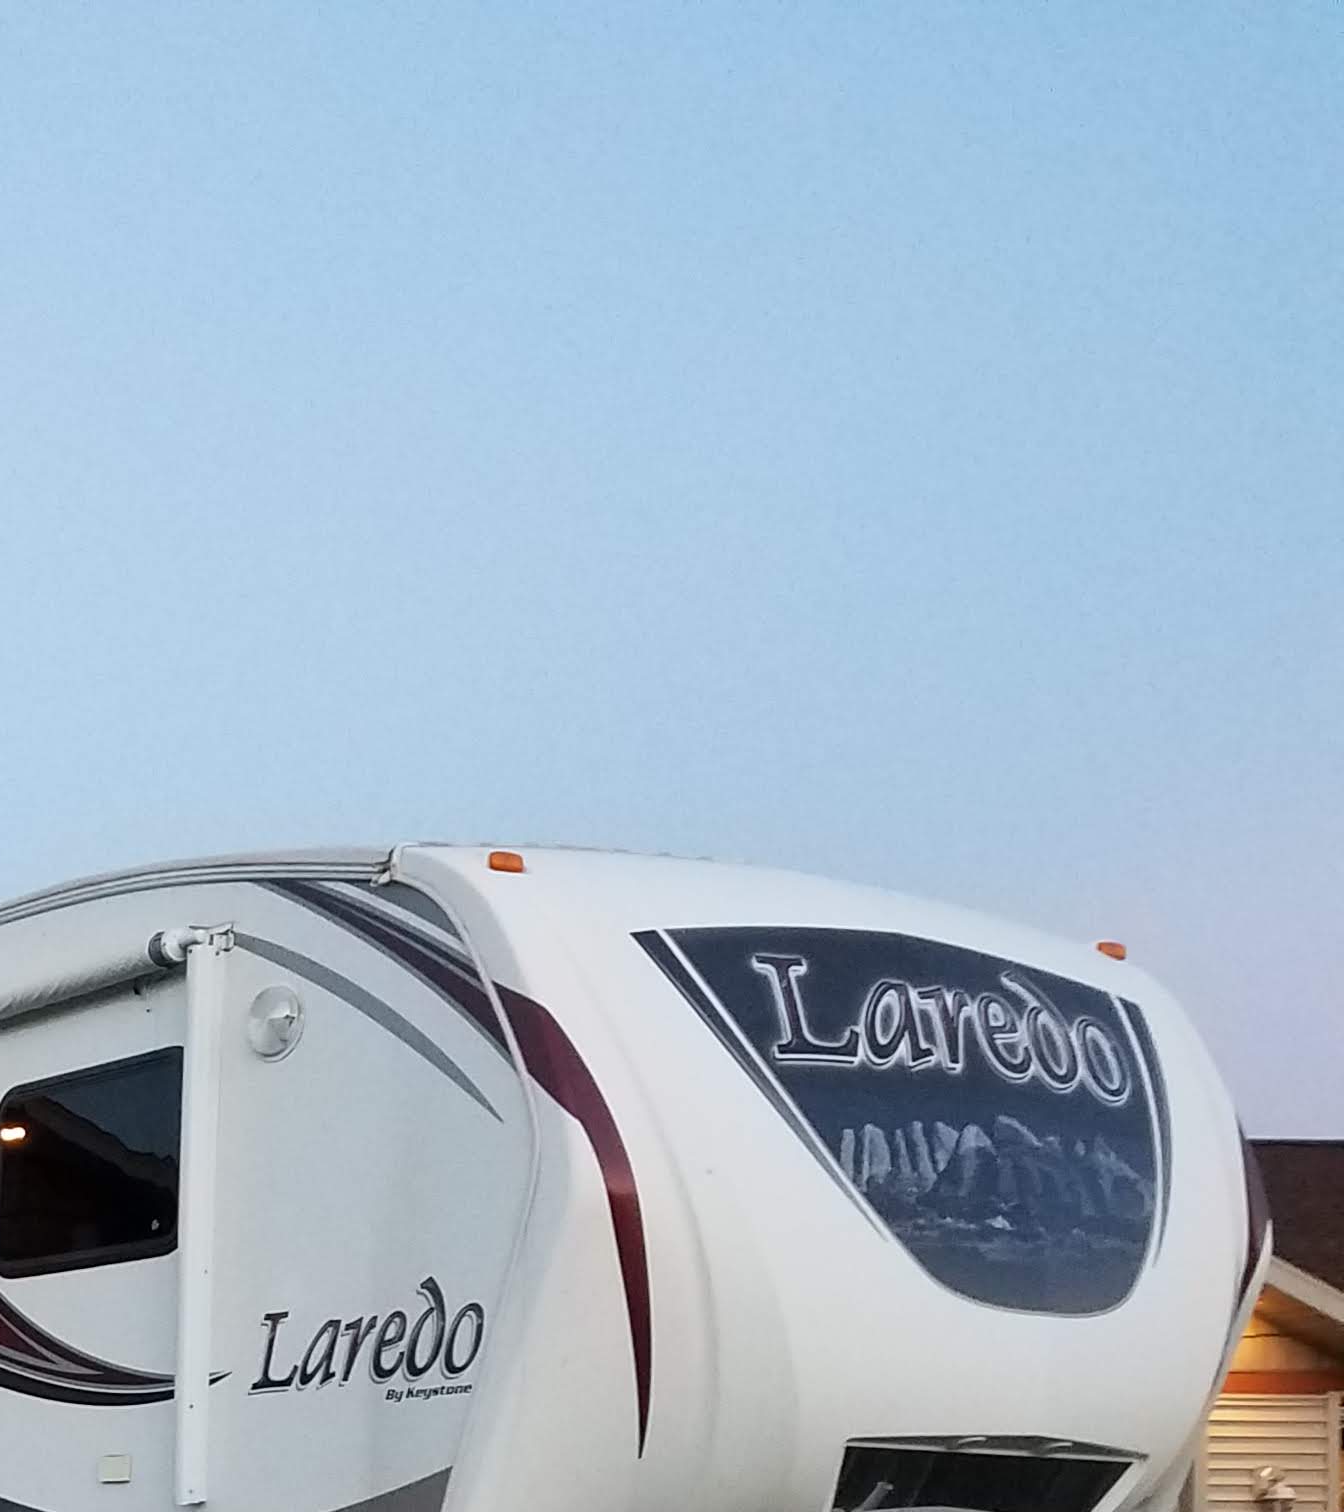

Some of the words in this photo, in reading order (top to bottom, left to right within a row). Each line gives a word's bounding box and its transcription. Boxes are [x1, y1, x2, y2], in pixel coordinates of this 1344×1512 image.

[751, 953, 1131, 1105] Laredo
[248, 1275, 485, 1396] Laredo
[385, 1388, 404, 1403] By
[405, 1384, 473, 1401] Keystone
